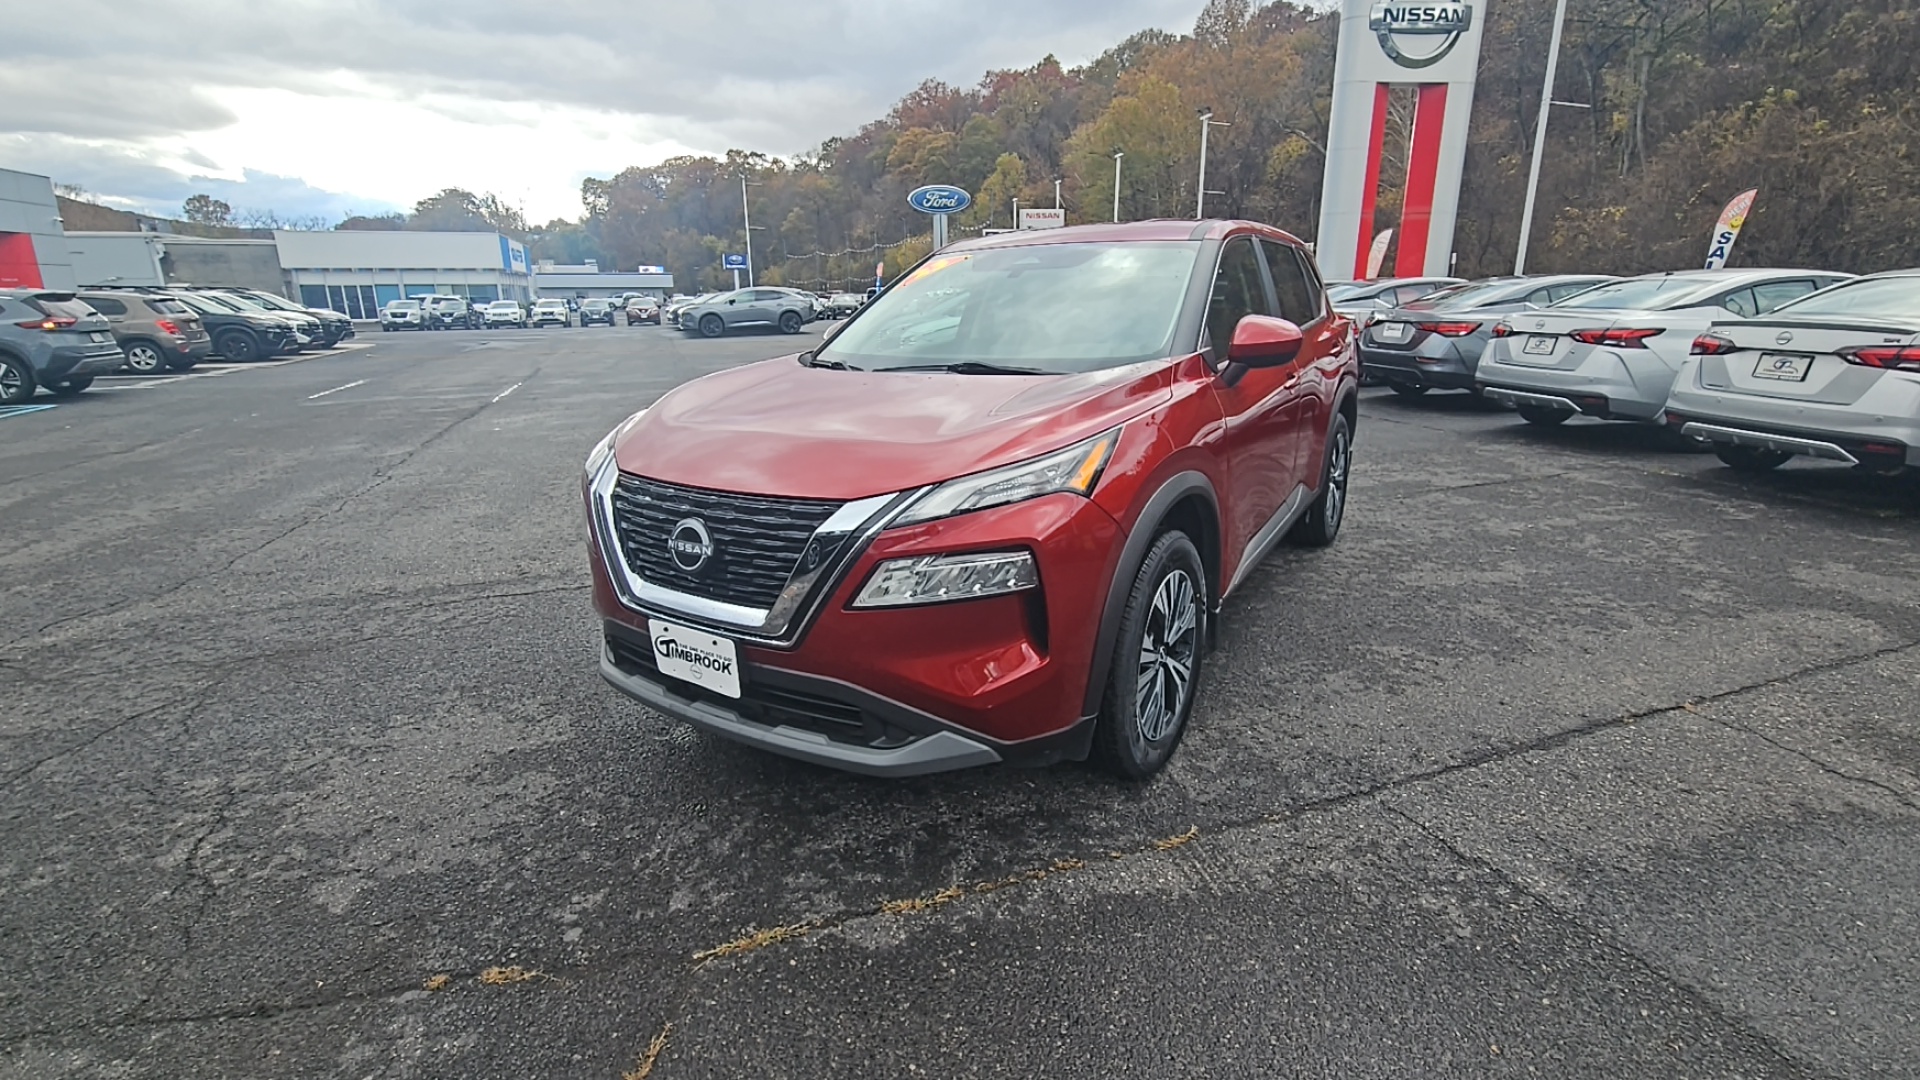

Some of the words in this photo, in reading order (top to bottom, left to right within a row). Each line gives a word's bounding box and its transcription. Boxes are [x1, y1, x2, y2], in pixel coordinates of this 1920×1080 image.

[1382, 7, 1466, 23] NISSAN
[922, 190, 958, 207] Ford
[667, 538, 711, 556] NISSAN
[655, 636, 732, 675] TIMBROOK
